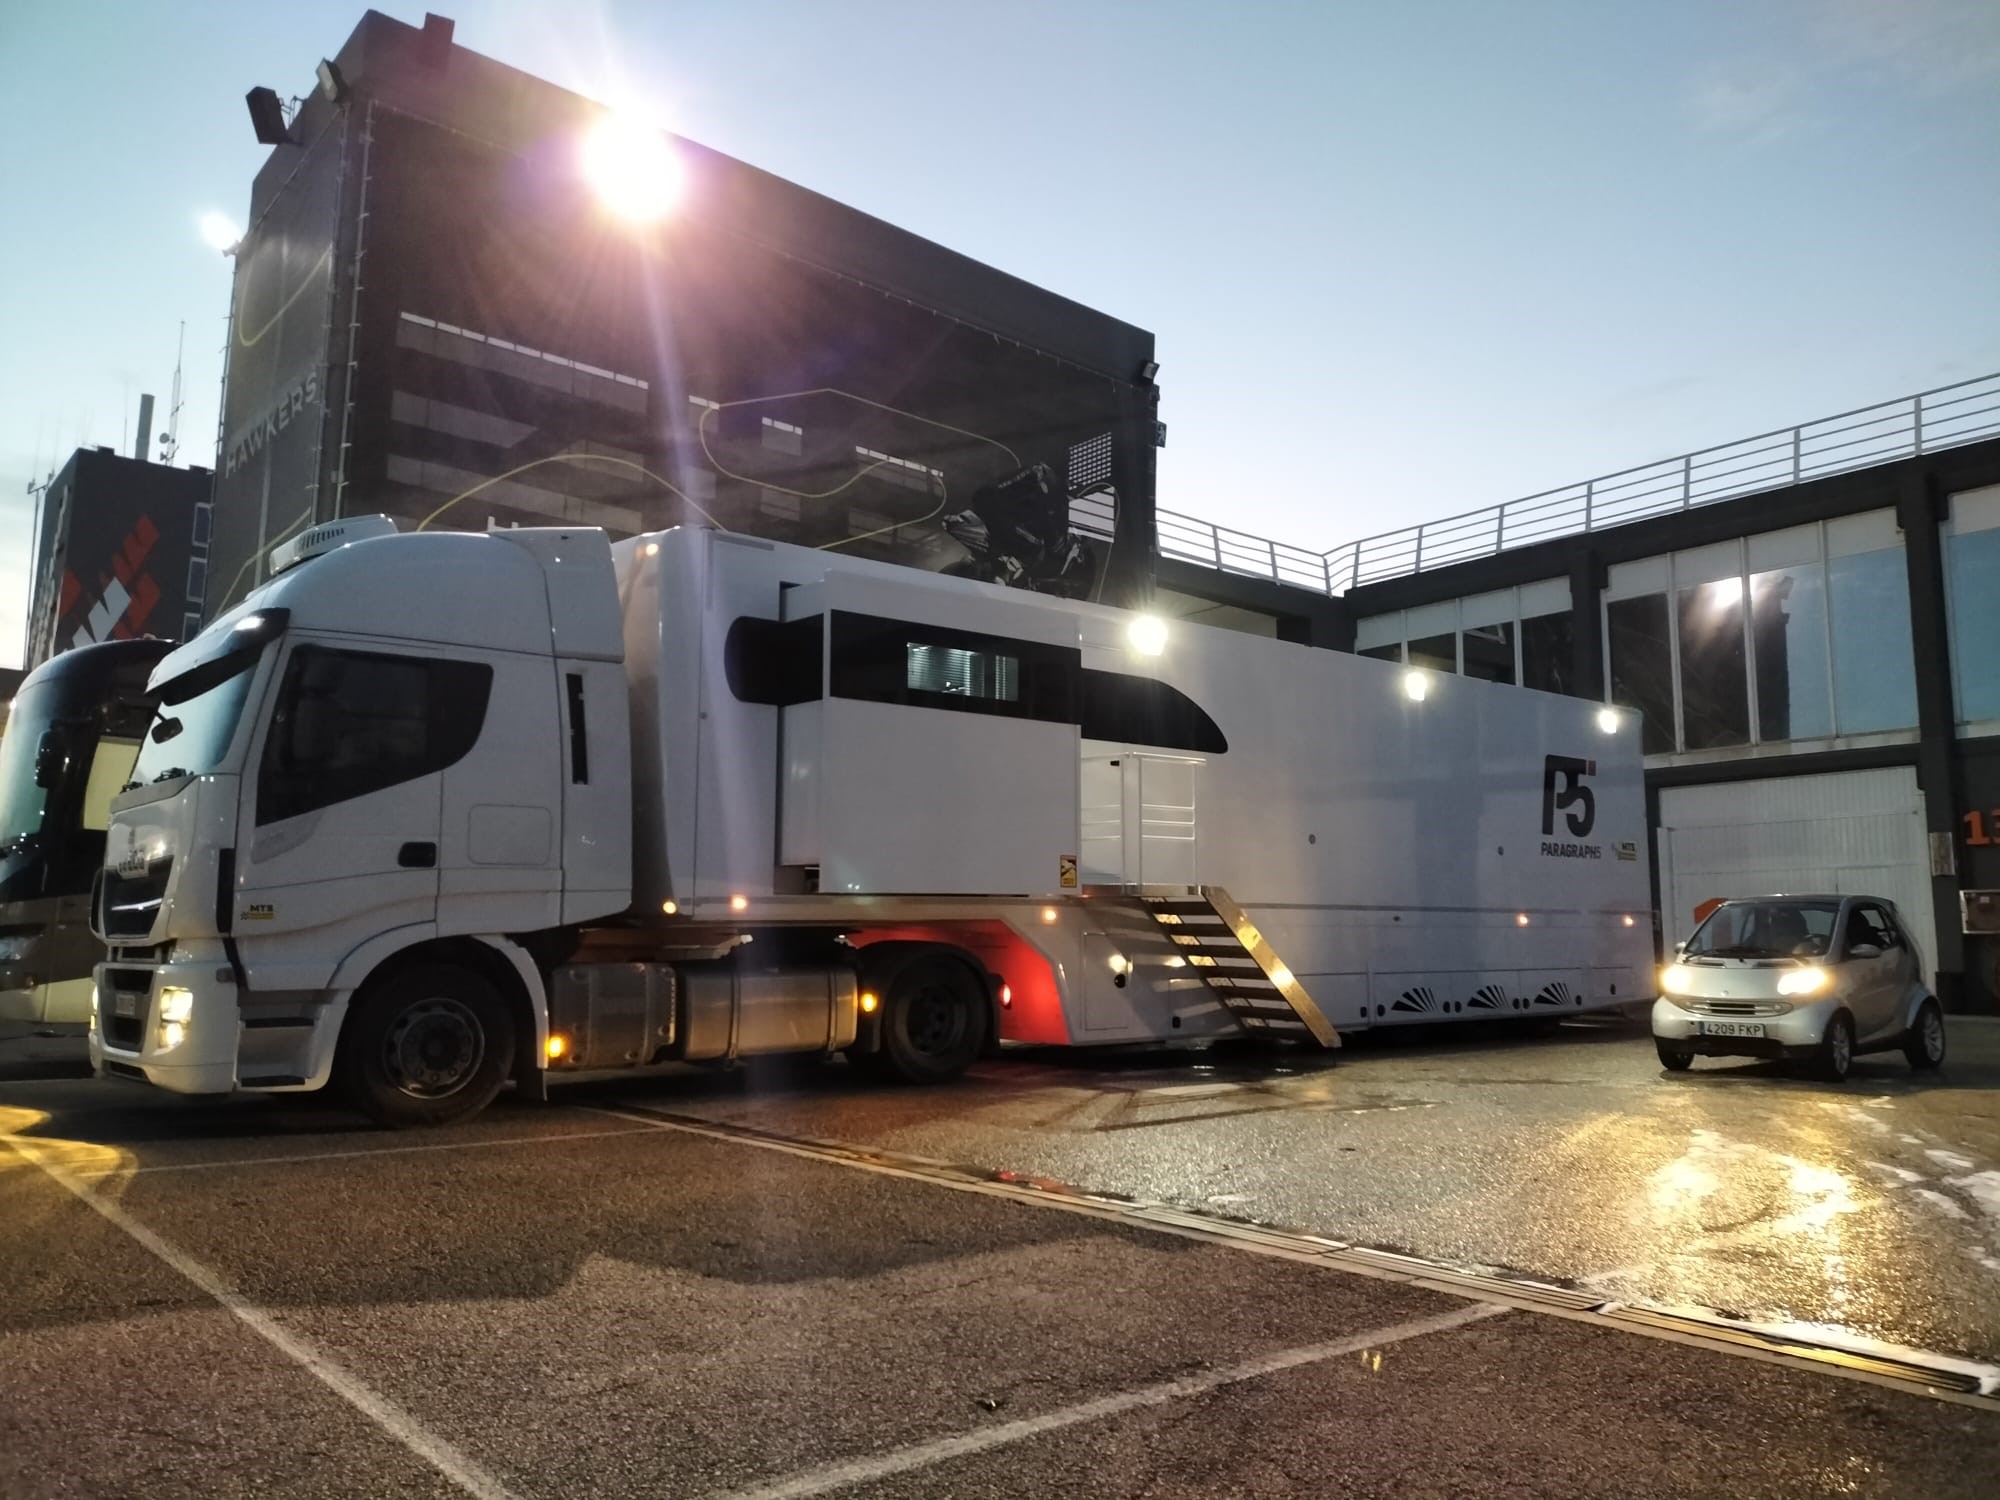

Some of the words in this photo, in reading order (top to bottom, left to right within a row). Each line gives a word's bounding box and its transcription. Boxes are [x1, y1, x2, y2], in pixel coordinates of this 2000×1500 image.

[225, 371, 317, 478] HAWKERS
[1707, 1023, 1735, 1034] 4209
[1738, 1025, 1761, 1036] FKP
